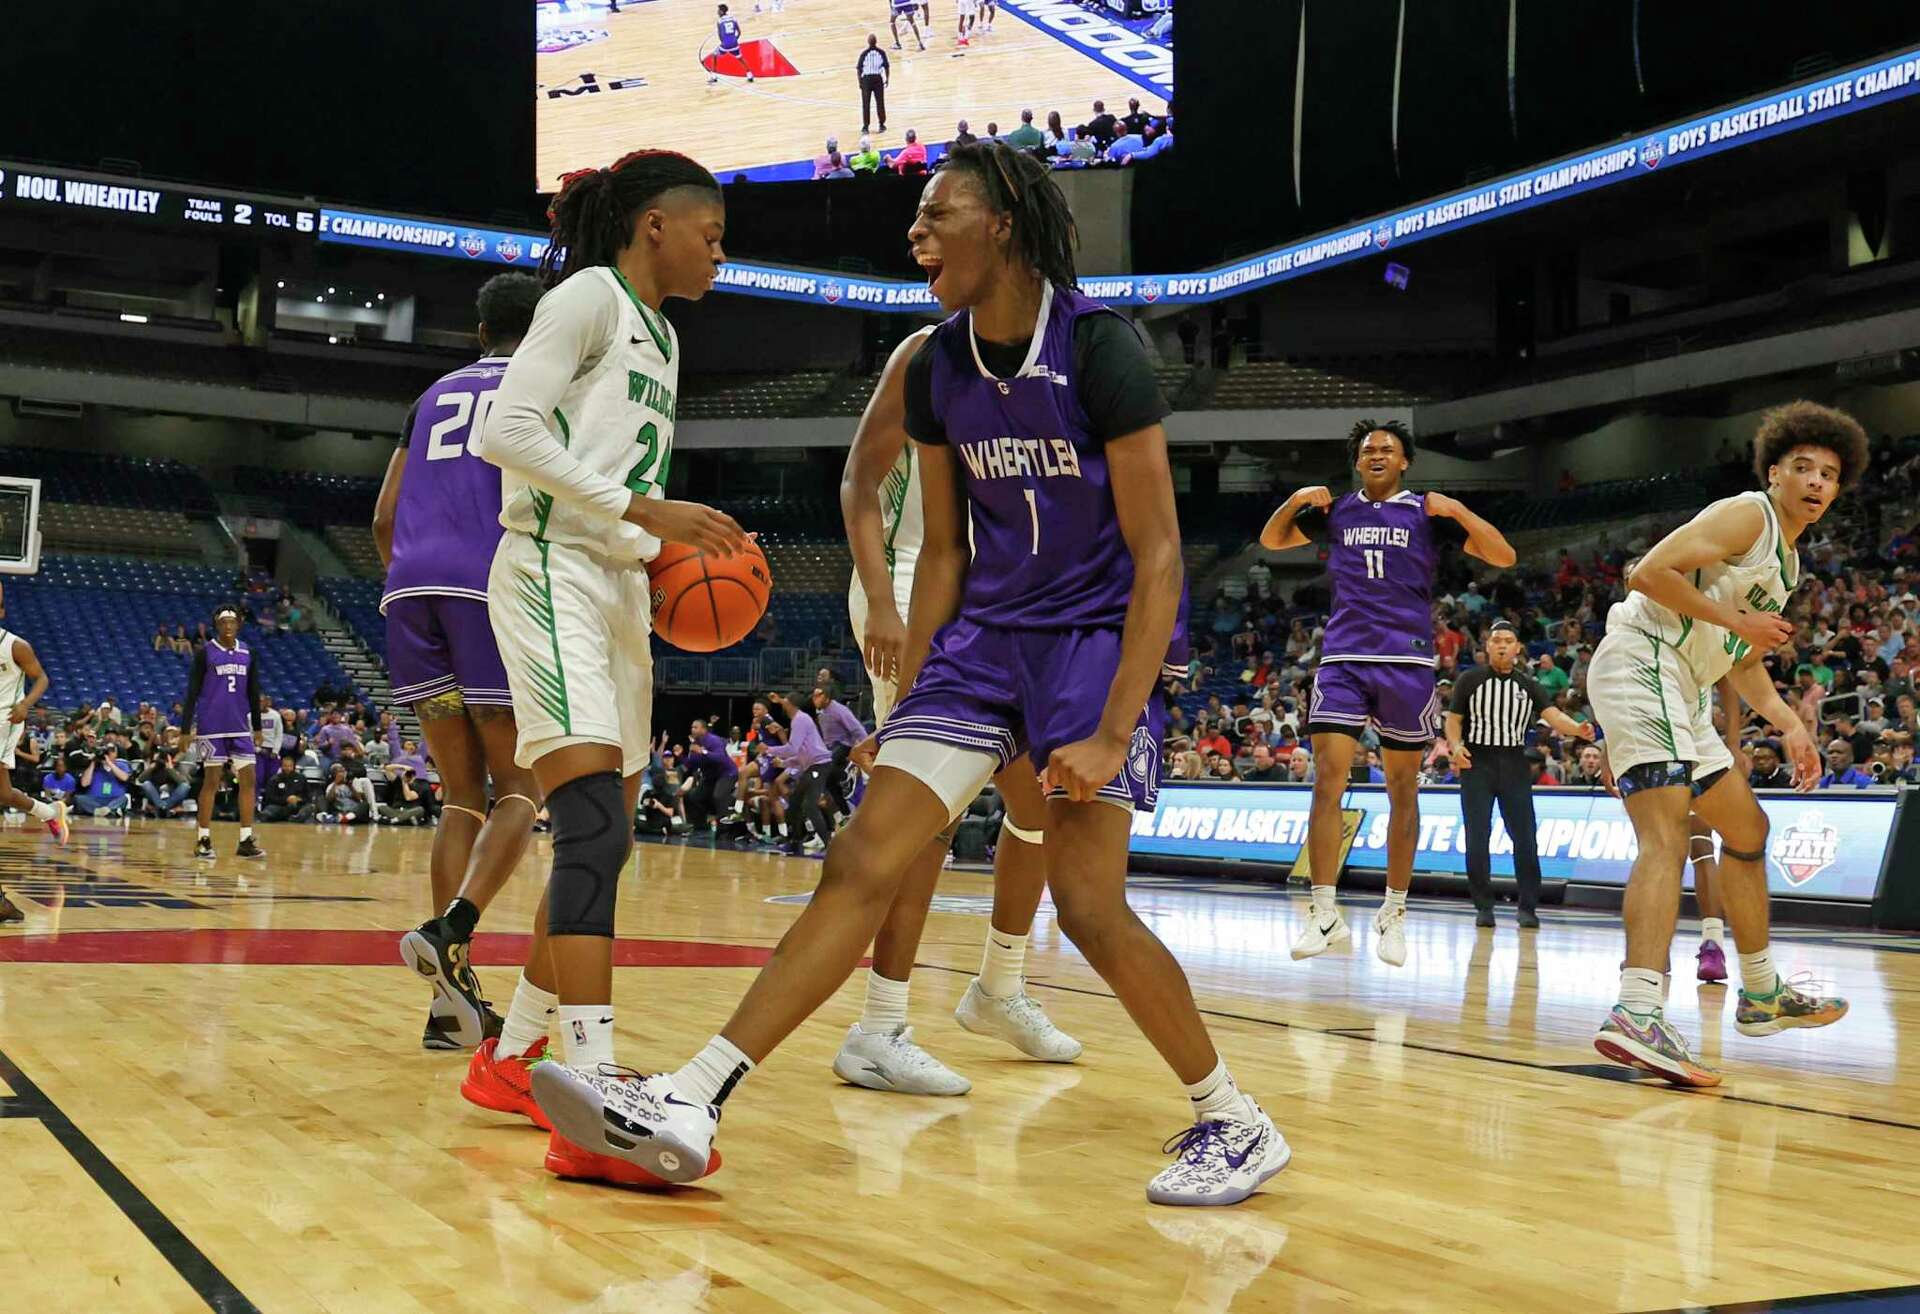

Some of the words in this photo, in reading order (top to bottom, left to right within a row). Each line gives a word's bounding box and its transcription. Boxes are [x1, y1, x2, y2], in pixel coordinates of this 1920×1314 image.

[1668, 125, 1706, 155] BOYS
[1710, 95, 1804, 143] BASKETBALL
[1808, 80, 1852, 113] STATE
[16, 175, 61, 202] HOU.
[65, 181, 160, 213] WHEATLEY
[188, 199, 221, 212] TEAM
[1395, 213, 1424, 237] BOYS
[1426, 192, 1497, 227] BASKETBALL
[1498, 179, 1531, 206] STATE
[1534, 147, 1636, 195] CHAMPIONSHIPS
[184, 210, 223, 223] FOULS
[234, 204, 252, 224] 2
[264, 212, 290, 227] TOL
[296, 212, 314, 232] 5
[332, 218, 456, 248] CHAMPIONSHIPS
[1167, 279, 1207, 296] BOYS
[1208, 262, 1265, 294] BASKETBALL
[1266, 254, 1292, 276] STATE
[1293, 229, 1372, 268] CHAMPIONSHIPS
[848, 284, 883, 303] BOYS
[960, 437, 1082, 480] WHEATLEY
[1023, 489, 1039, 555] 1
[1344, 527, 1409, 548] WHEATLEY
[1364, 550, 1384, 579] 11
[228, 676, 236, 692] 2
[1156, 806, 1218, 840] BOYS
